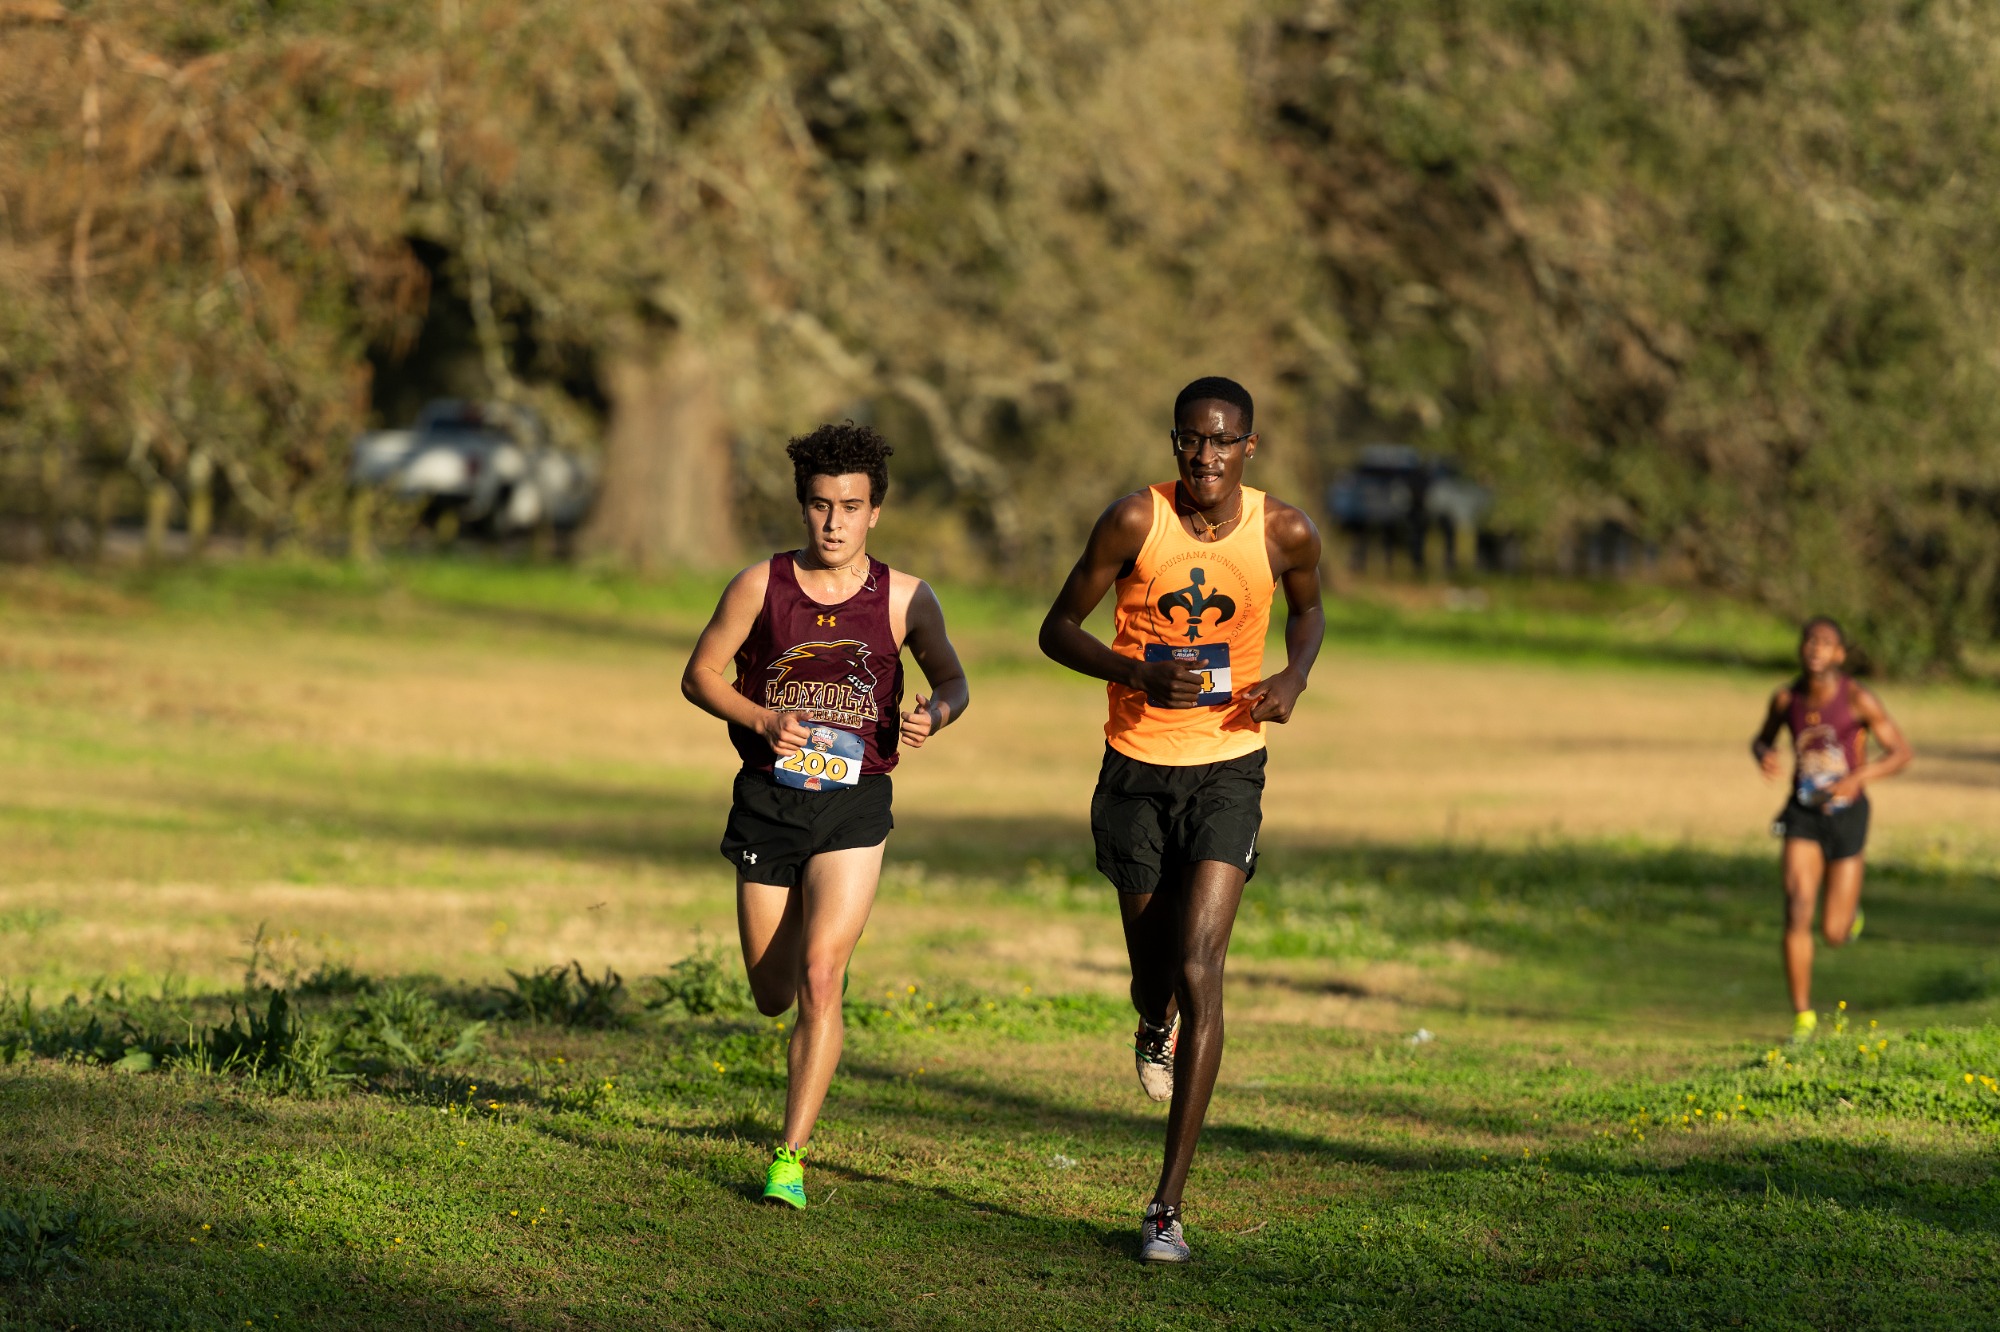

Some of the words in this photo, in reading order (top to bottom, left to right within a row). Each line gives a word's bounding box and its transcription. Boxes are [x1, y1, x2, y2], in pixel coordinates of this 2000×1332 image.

[1155, 551, 1207, 577] LOUISIANA
[1209, 552, 1248, 588] RUNNING
[1231, 592, 1252, 638] WALKING
[767, 680, 878, 720] LOYOLA
[808, 709, 861, 728] RLEANS
[782, 748, 848, 782] 200
